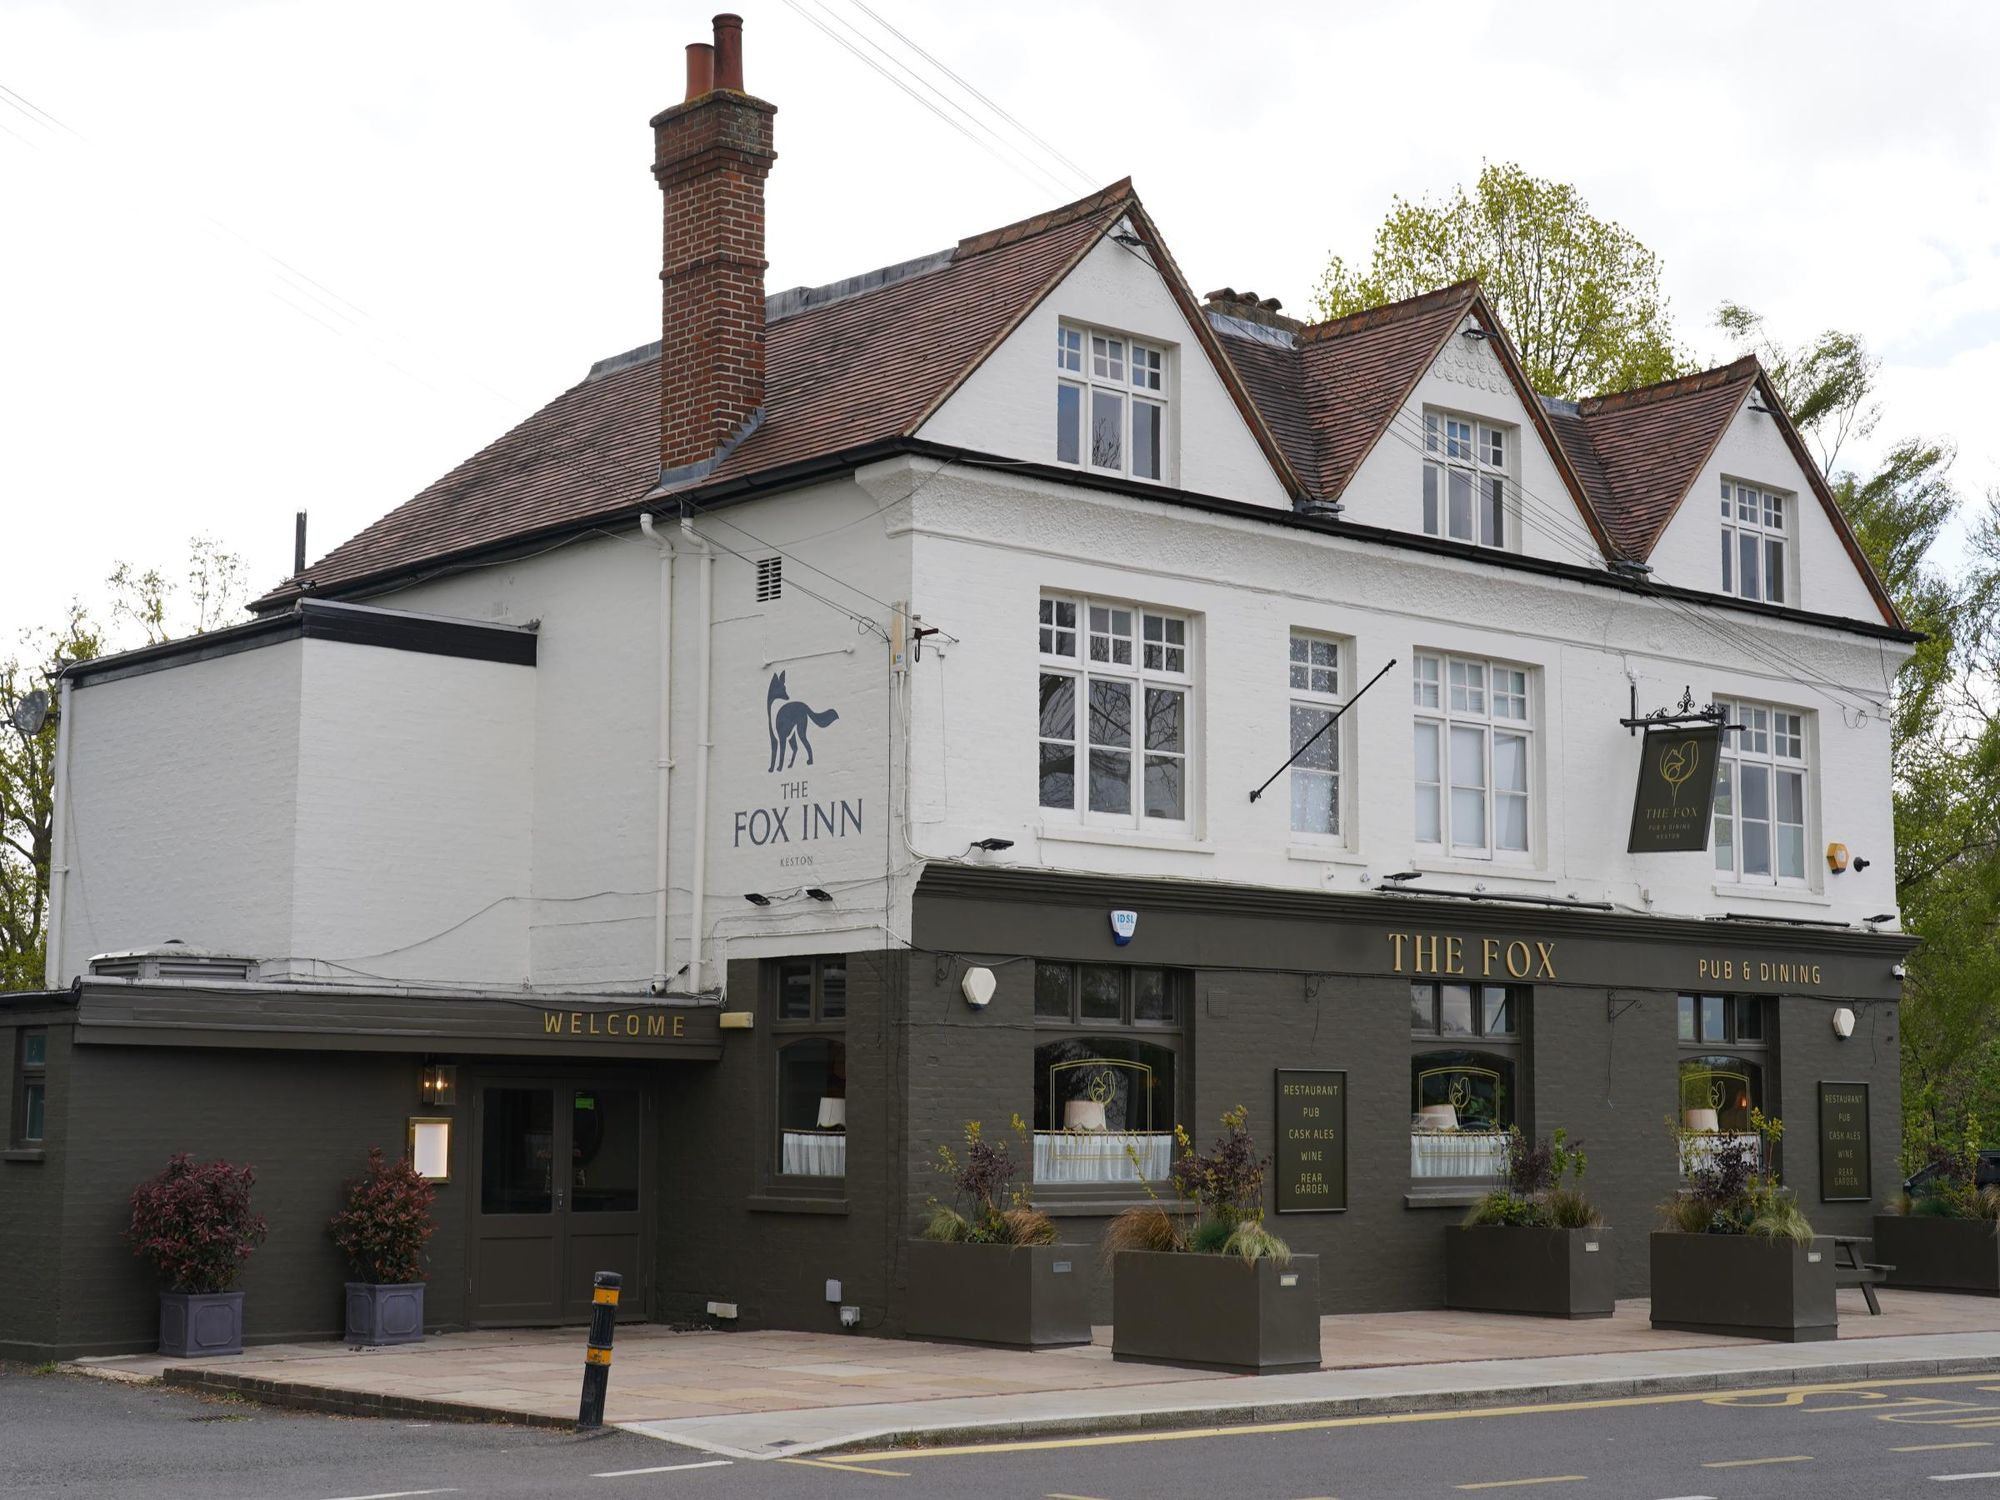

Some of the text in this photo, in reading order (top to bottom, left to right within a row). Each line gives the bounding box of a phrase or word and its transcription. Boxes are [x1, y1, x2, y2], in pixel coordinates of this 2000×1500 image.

[781, 781, 808, 800] THE
[1645, 807, 1698, 819] THE FOX
[734, 798, 863, 848] FOX INN
[780, 855, 813, 867] KESTON
[1116, 913, 1135, 924] IDSL
[1387, 933, 1557, 979] THE FOX
[1698, 958, 1822, 985] PUB & DINING
[544, 1011, 685, 1037] WELCOME
[1284, 1084, 1339, 1096] RESTAURANT
[1824, 1094, 1863, 1104] RESTAURANT
[1303, 1107, 1320, 1118] PUB
[1838, 1112, 1851, 1122] PUB
[1288, 1128, 1335, 1140] CASK ALES
[1828, 1131, 1862, 1141] CASK ALES
[1300, 1150, 1323, 1161] WINE
[1837, 1149, 1854, 1159] WINE
[1300, 1172, 1323, 1183] REAR
[1838, 1167, 1854, 1176] REAR
[1294, 1183, 1329, 1195] GARDEN
